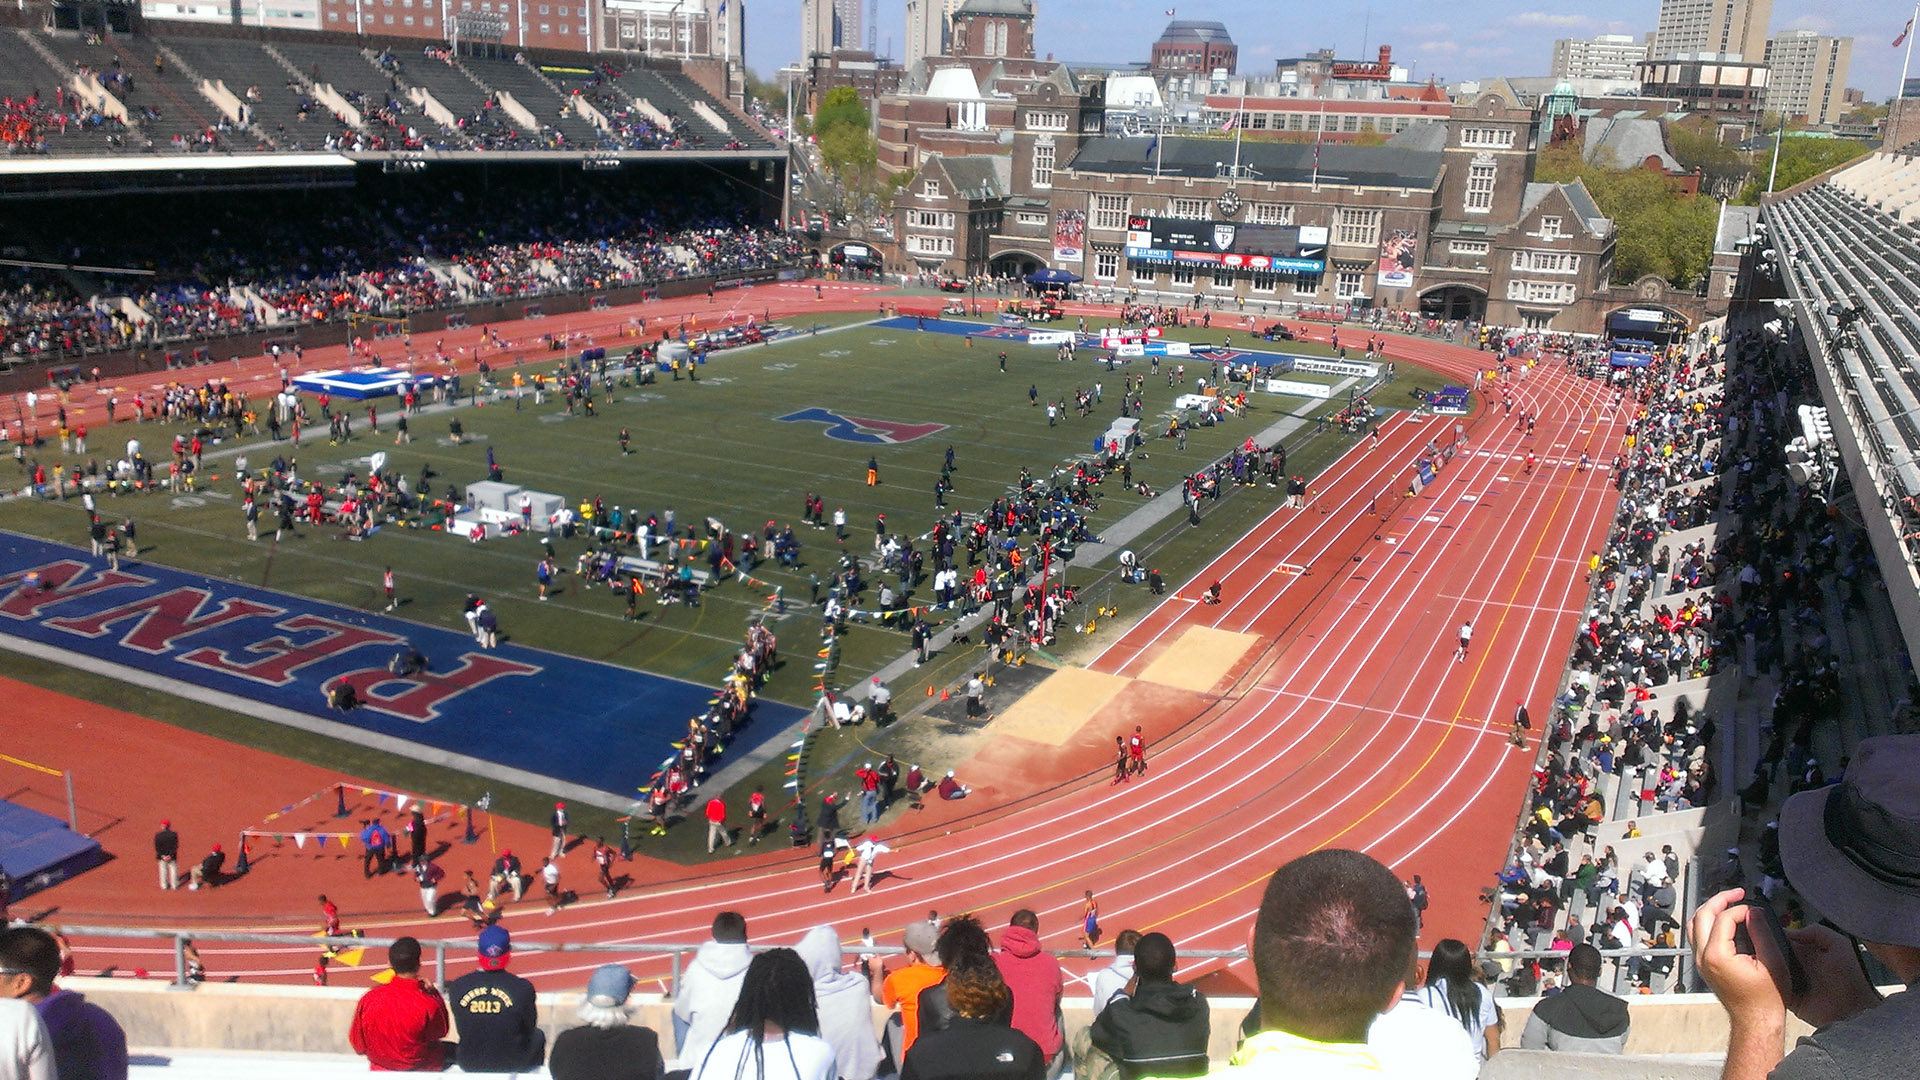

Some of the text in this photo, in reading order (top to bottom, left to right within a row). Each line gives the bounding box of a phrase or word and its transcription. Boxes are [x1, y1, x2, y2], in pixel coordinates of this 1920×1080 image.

[1141, 207, 1289, 226] FRANKLIN FIELD
[1148, 249, 1168, 257] WHITE
[1146, 258, 1177, 266] ROBERT
[1211, 263, 1241, 271] FAMILY
[1243, 265, 1300, 275] SCOREBOARD
[469, 1000, 502, 1013] 2013
